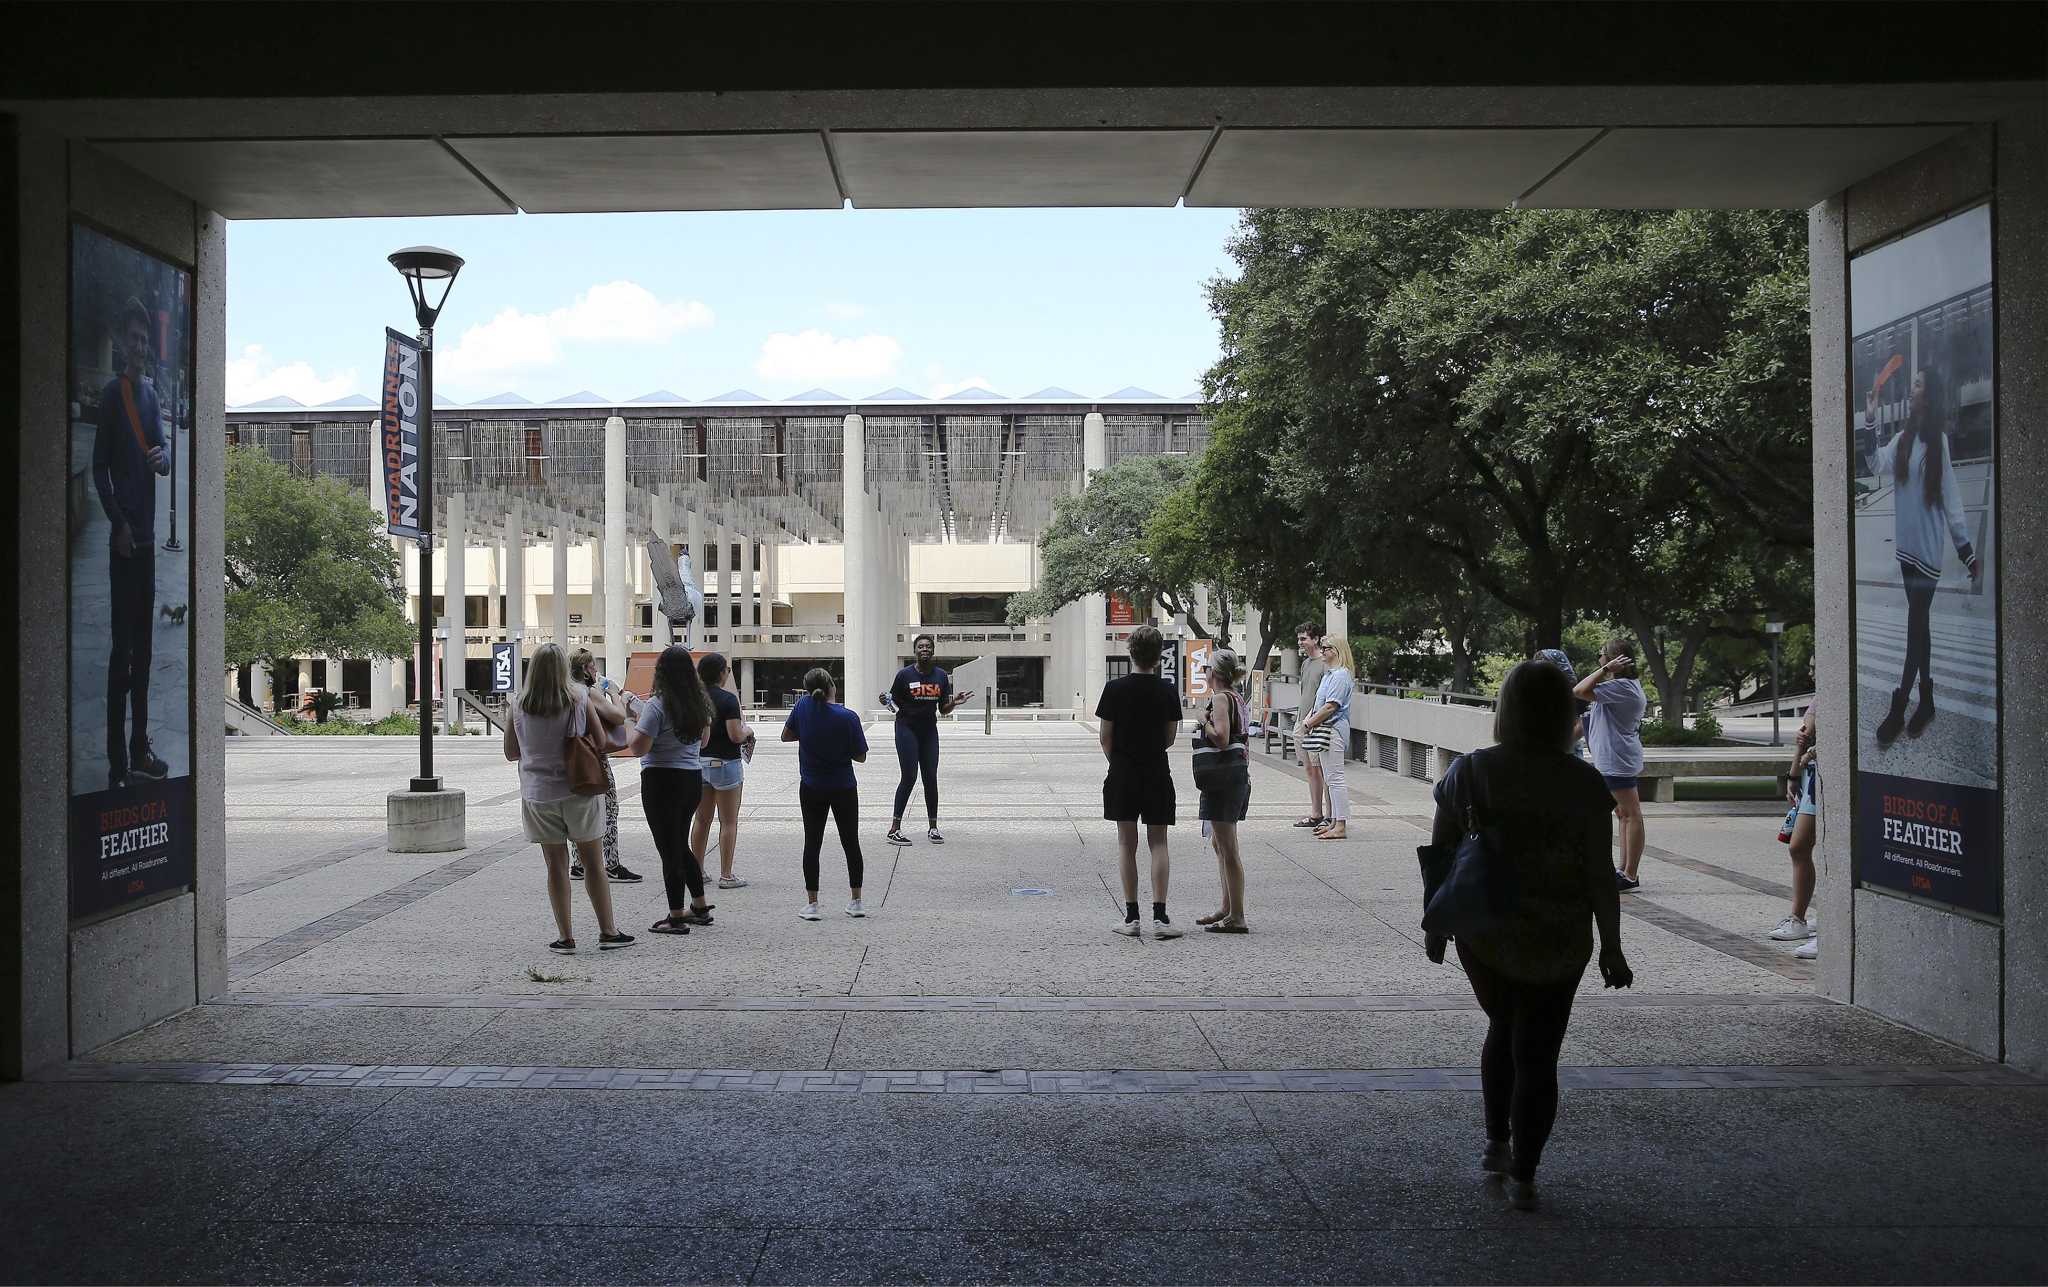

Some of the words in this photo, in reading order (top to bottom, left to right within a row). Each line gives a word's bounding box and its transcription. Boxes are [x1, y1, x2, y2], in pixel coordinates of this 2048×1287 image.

[384, 338, 401, 526] ROADRUNNER
[399, 344, 418, 528] NATION
[496, 646, 512, 690] UTSA
[101, 806, 138, 831] BIRDS
[141, 801, 159, 822] OF
[160, 800, 168, 818] A
[1883, 795, 1924, 820] BIRDS
[1927, 803, 1946, 823] OF
[1951, 807, 1961, 825] A
[100, 822, 169, 859] FEATHER
[1883, 817, 1963, 855] FEATHER
